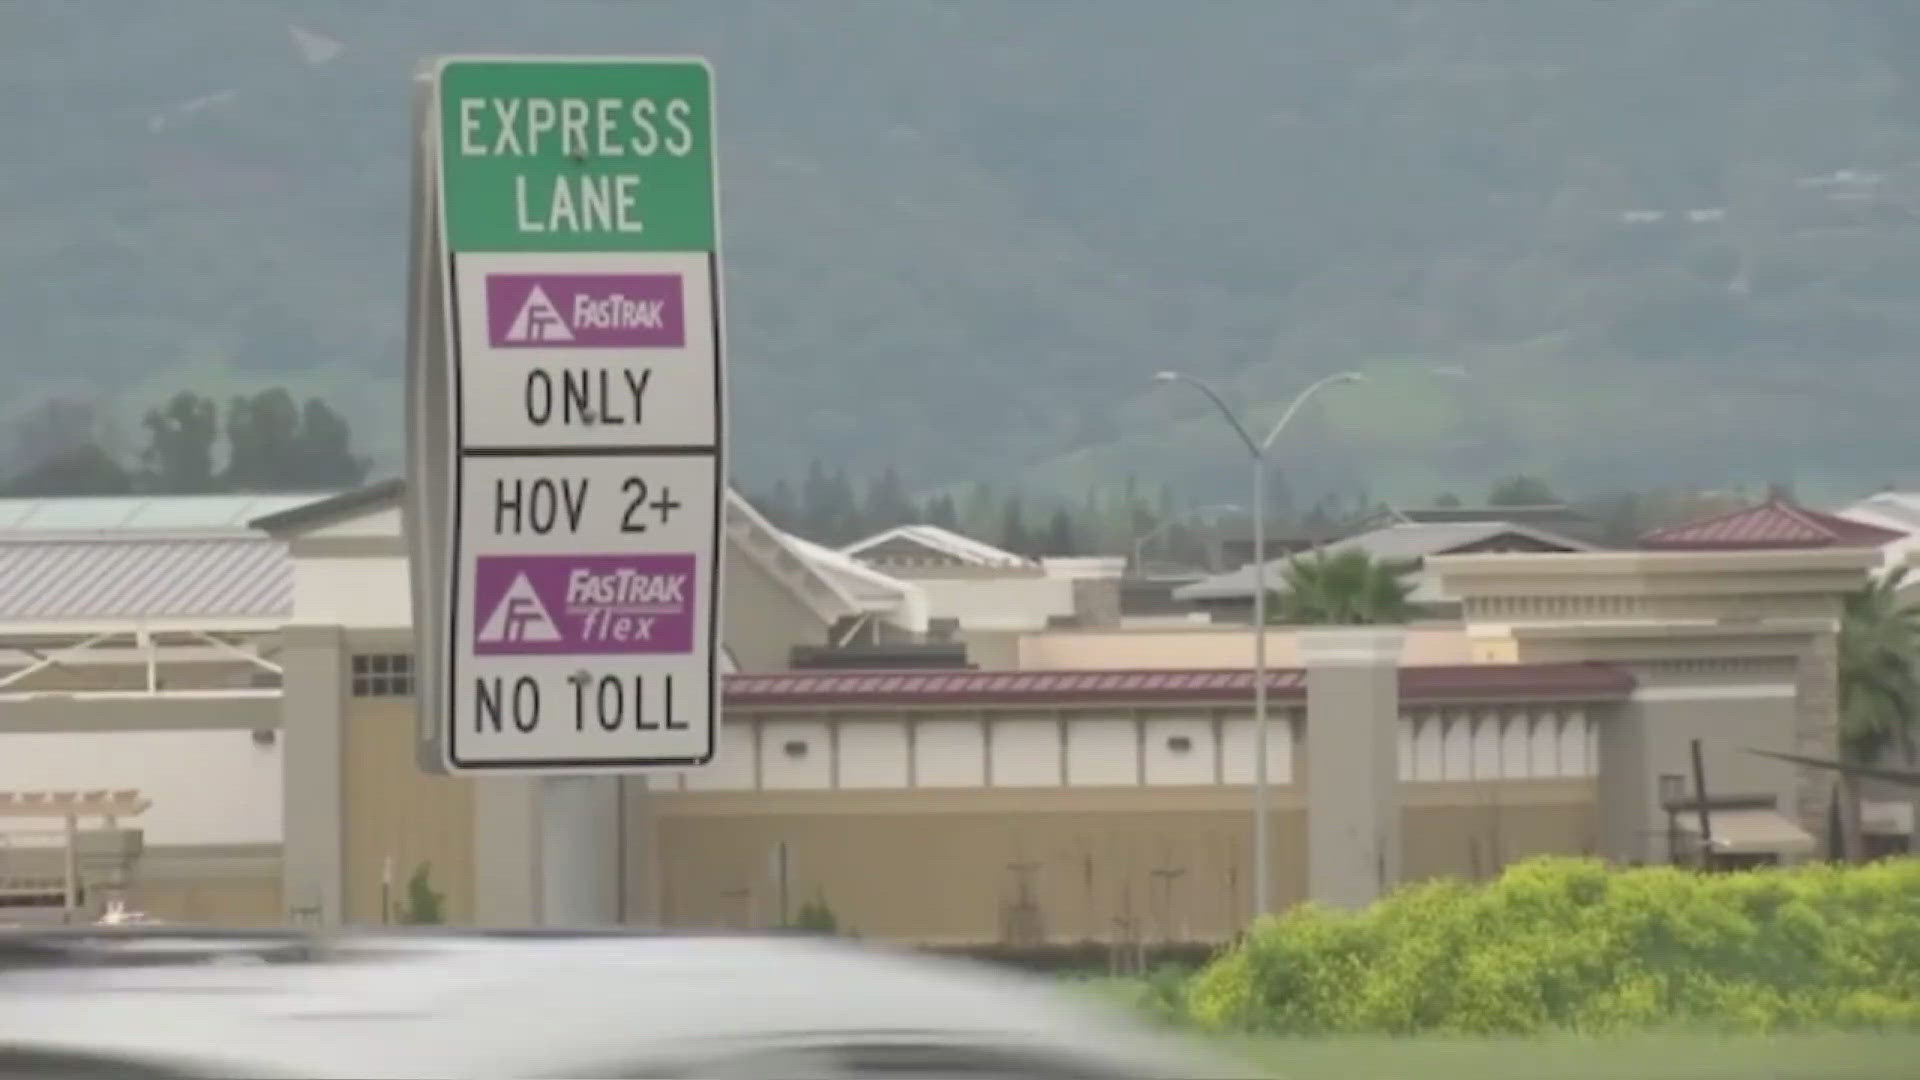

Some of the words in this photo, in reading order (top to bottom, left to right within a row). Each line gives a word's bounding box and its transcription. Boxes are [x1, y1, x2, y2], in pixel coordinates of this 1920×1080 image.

[460, 97, 694, 157] EXPRESS
[515, 174, 643, 232] LANE
[524, 367, 652, 426] ONLY
[494, 478, 588, 535] HOV
[620, 475, 682, 534] 2+
[581, 607, 656, 642] flex
[474, 675, 541, 734] NO
[566, 674, 690, 733] TOLL
